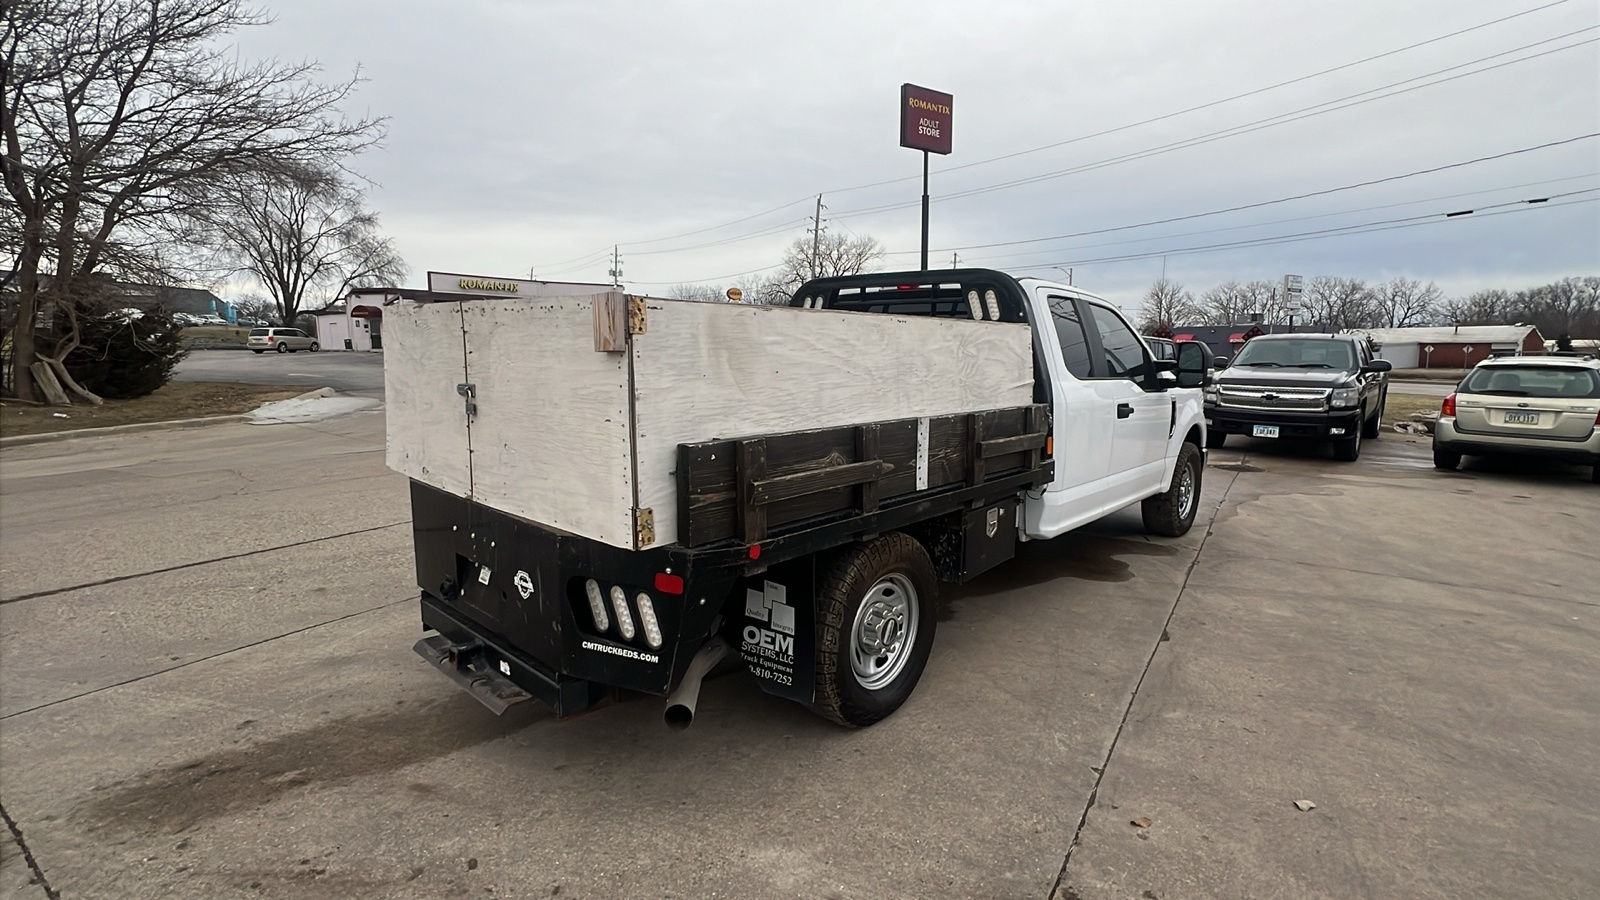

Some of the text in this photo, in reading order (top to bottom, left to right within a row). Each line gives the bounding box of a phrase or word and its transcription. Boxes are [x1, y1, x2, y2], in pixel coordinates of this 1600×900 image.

[909, 97, 950, 115] ROMANTIX
[918, 126, 940, 138] STORE
[919, 117, 939, 129] ADULT
[459, 279, 519, 293] ROMANTIX
[743, 625, 794, 656] OEM
[582, 641, 659, 664] CMTRUCKBEDS.COM
[741, 640, 795, 665] SYSTEMS, LLC
[740, 652, 793, 674] Truck Equipment
